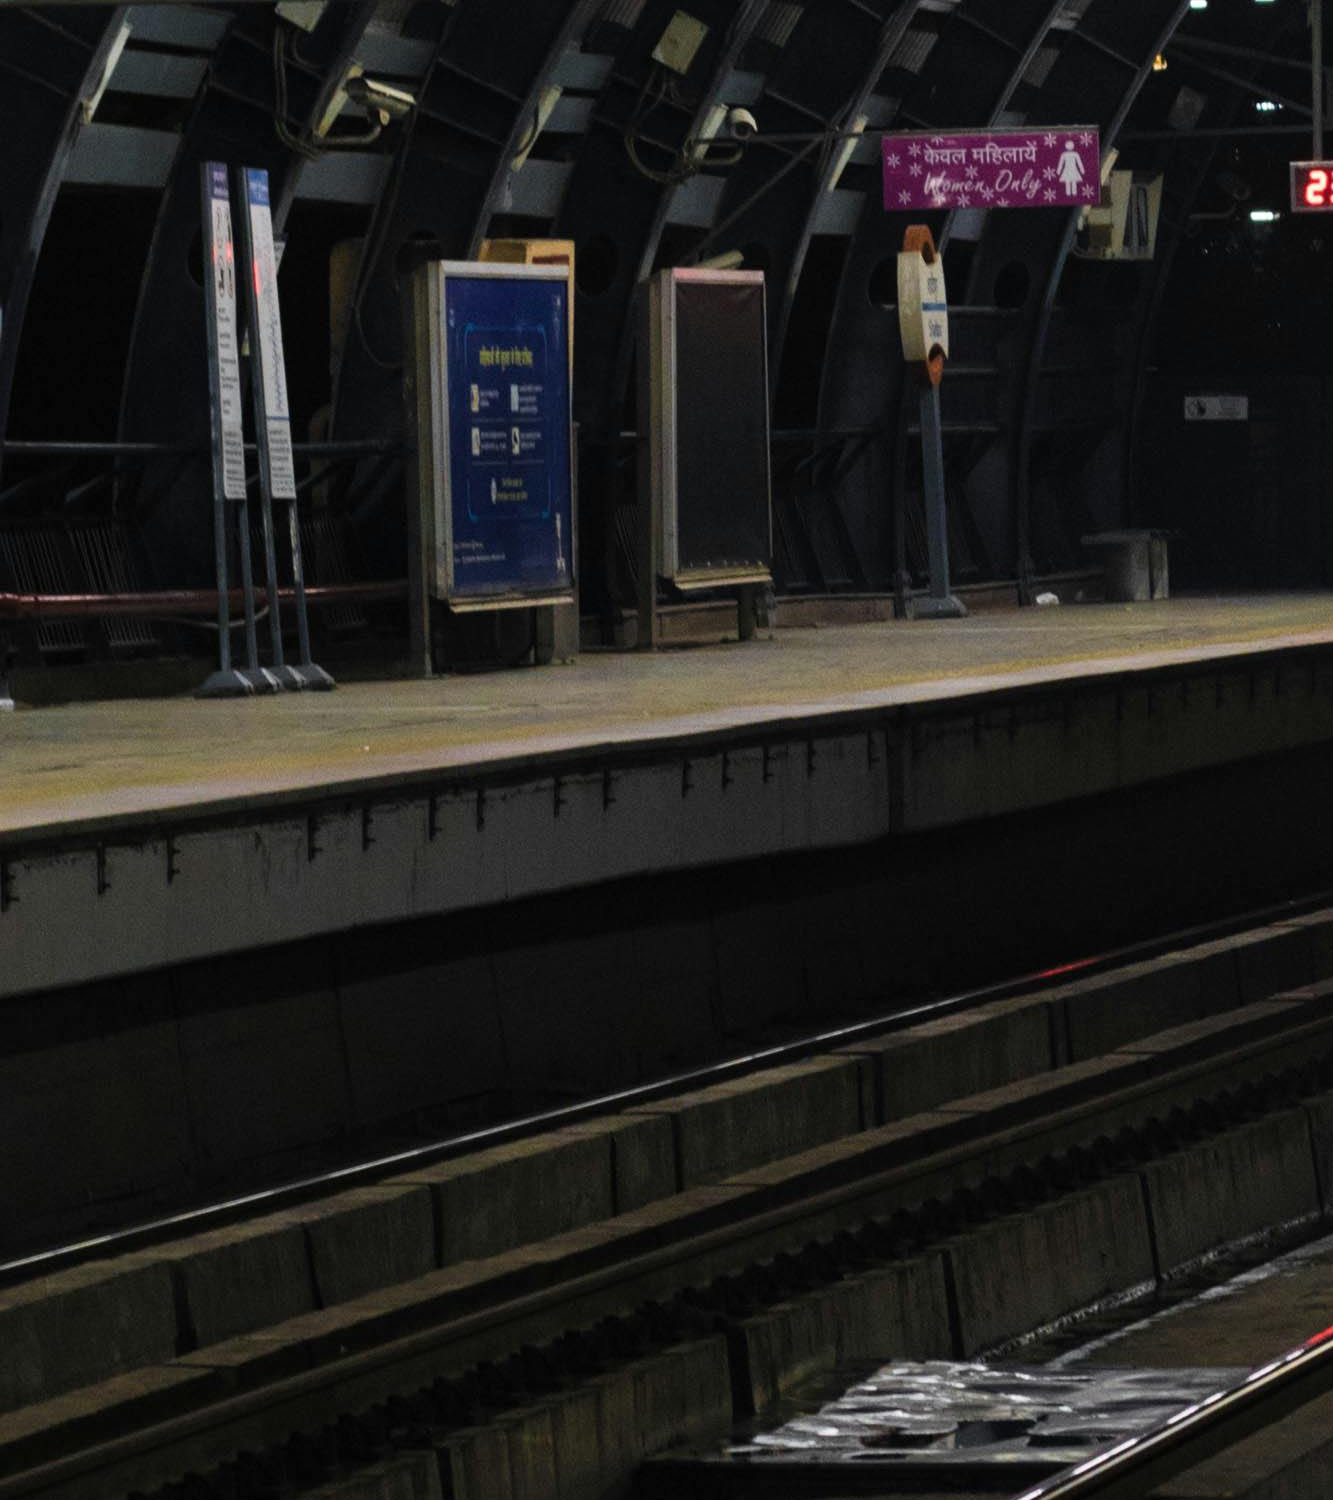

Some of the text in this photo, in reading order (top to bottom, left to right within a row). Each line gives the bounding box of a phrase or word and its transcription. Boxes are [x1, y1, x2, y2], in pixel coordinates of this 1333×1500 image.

[924, 144, 966, 164] केवल
[924, 169, 1041, 199] Women Only
